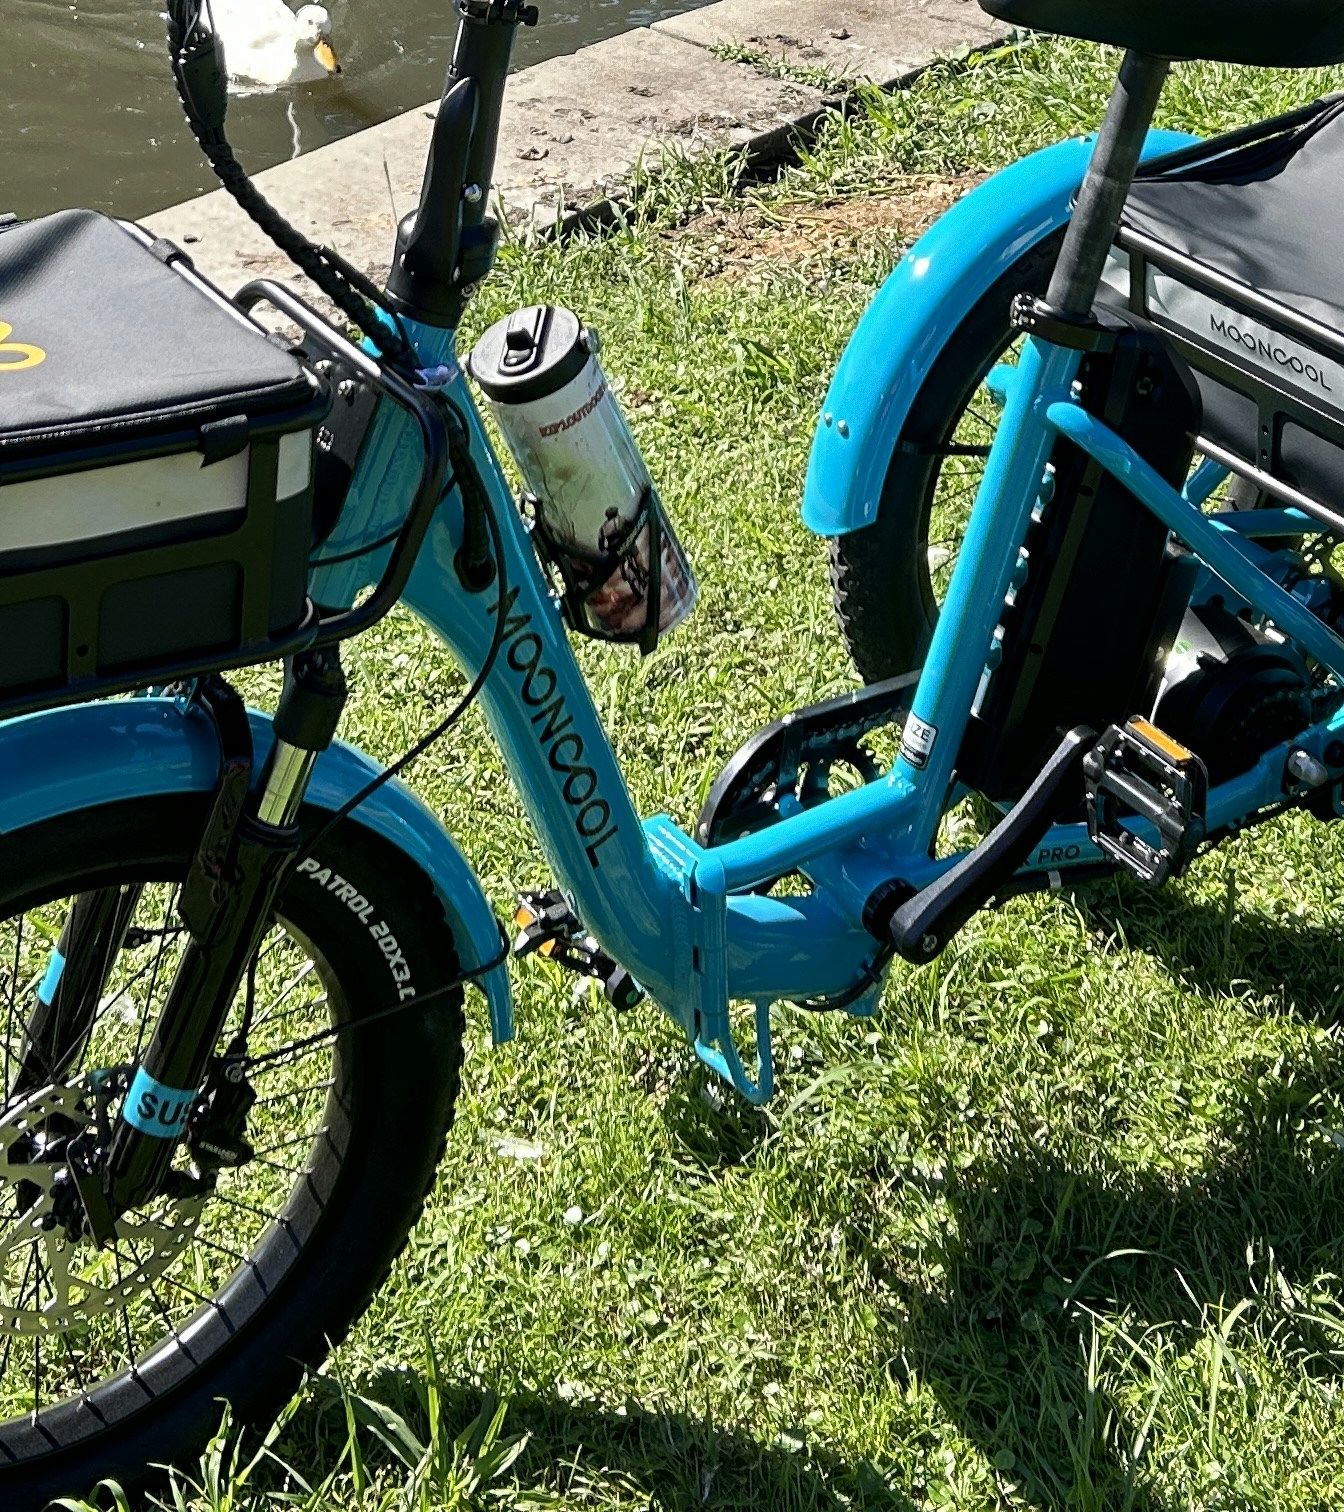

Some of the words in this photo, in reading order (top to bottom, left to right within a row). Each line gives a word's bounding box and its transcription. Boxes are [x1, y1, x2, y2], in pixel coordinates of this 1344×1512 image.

[1210, 313, 1333, 392] MOONCOOL
[487, 587, 619, 869] MOONCOOL
[295, 856, 375, 925] PATROL
[1038, 844, 1081, 865] PRO
